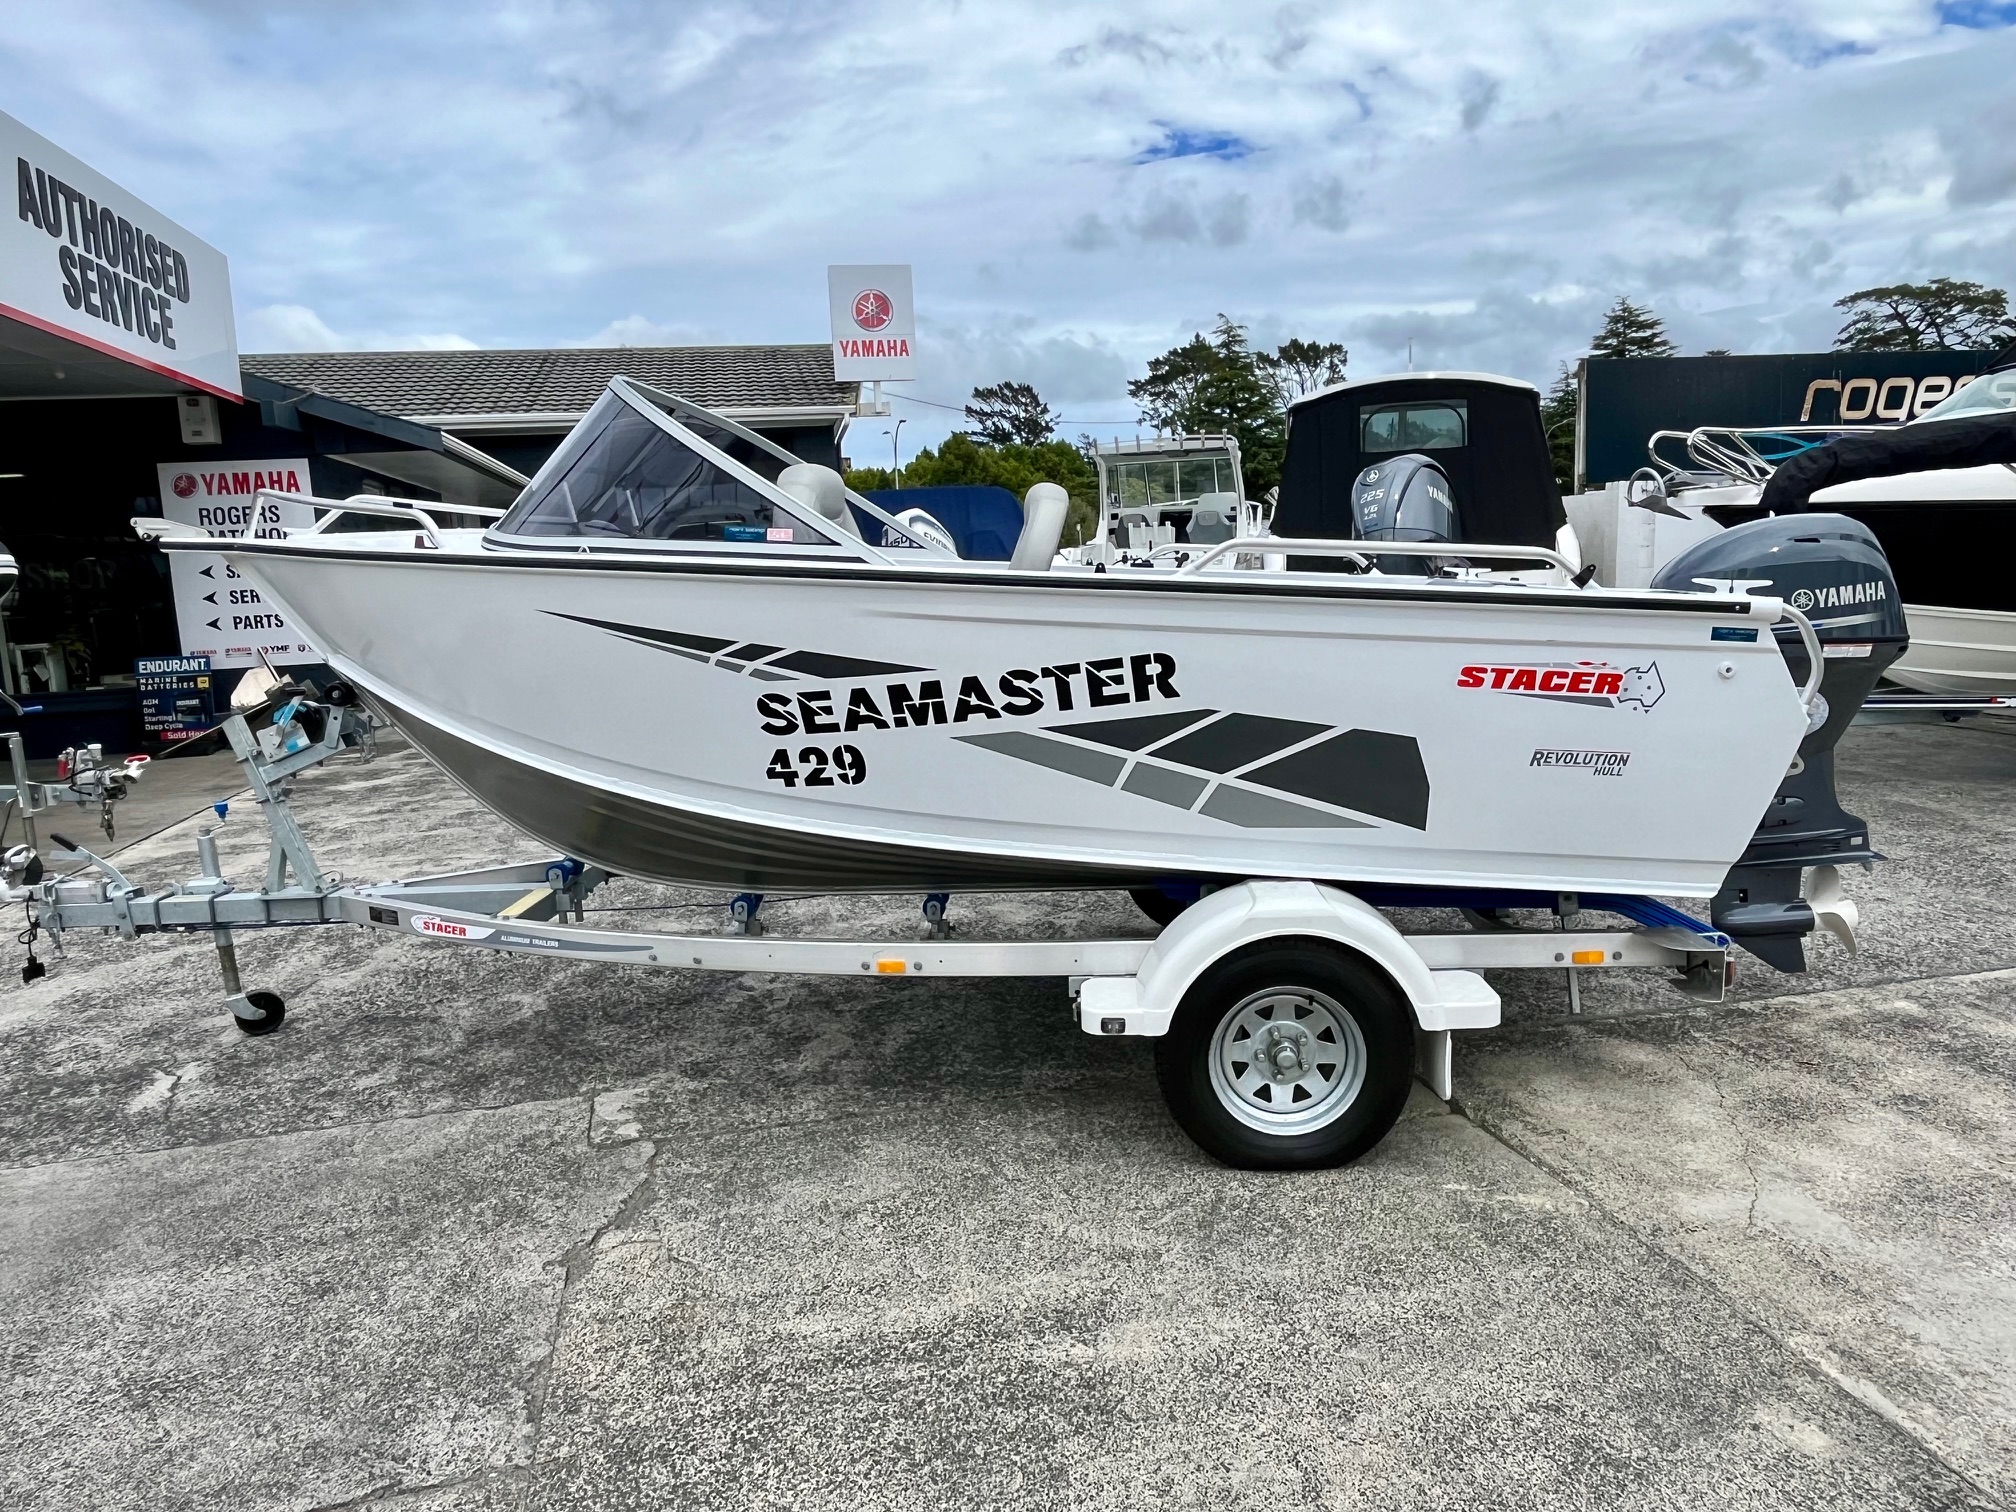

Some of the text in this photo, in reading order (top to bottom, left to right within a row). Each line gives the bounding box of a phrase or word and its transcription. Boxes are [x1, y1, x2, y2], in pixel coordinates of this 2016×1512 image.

[18, 157, 190, 304] AUTHORISED
[59, 245, 176, 350] SERVICE
[839, 339, 910, 358] YAMAHA
[200, 470, 301, 496] YAMAHA
[1360, 488, 1385, 504] 225
[198, 505, 281, 526] ROGERS
[1815, 581, 1886, 608] YAMAHA
[233, 614, 284, 630] PARTS
[139, 658, 206, 673] ENDURANT
[140, 682, 194, 690] BATTERIES
[1457, 665, 1624, 695] STACER
[756, 651, 1181, 737] SEAMASTER
[167, 731, 187, 739] Sold
[766, 744, 867, 788] 429
[1529, 749, 1631, 767] REVOLUTION
[1593, 766, 1623, 776] HULL
[423, 920, 467, 937] STACER
